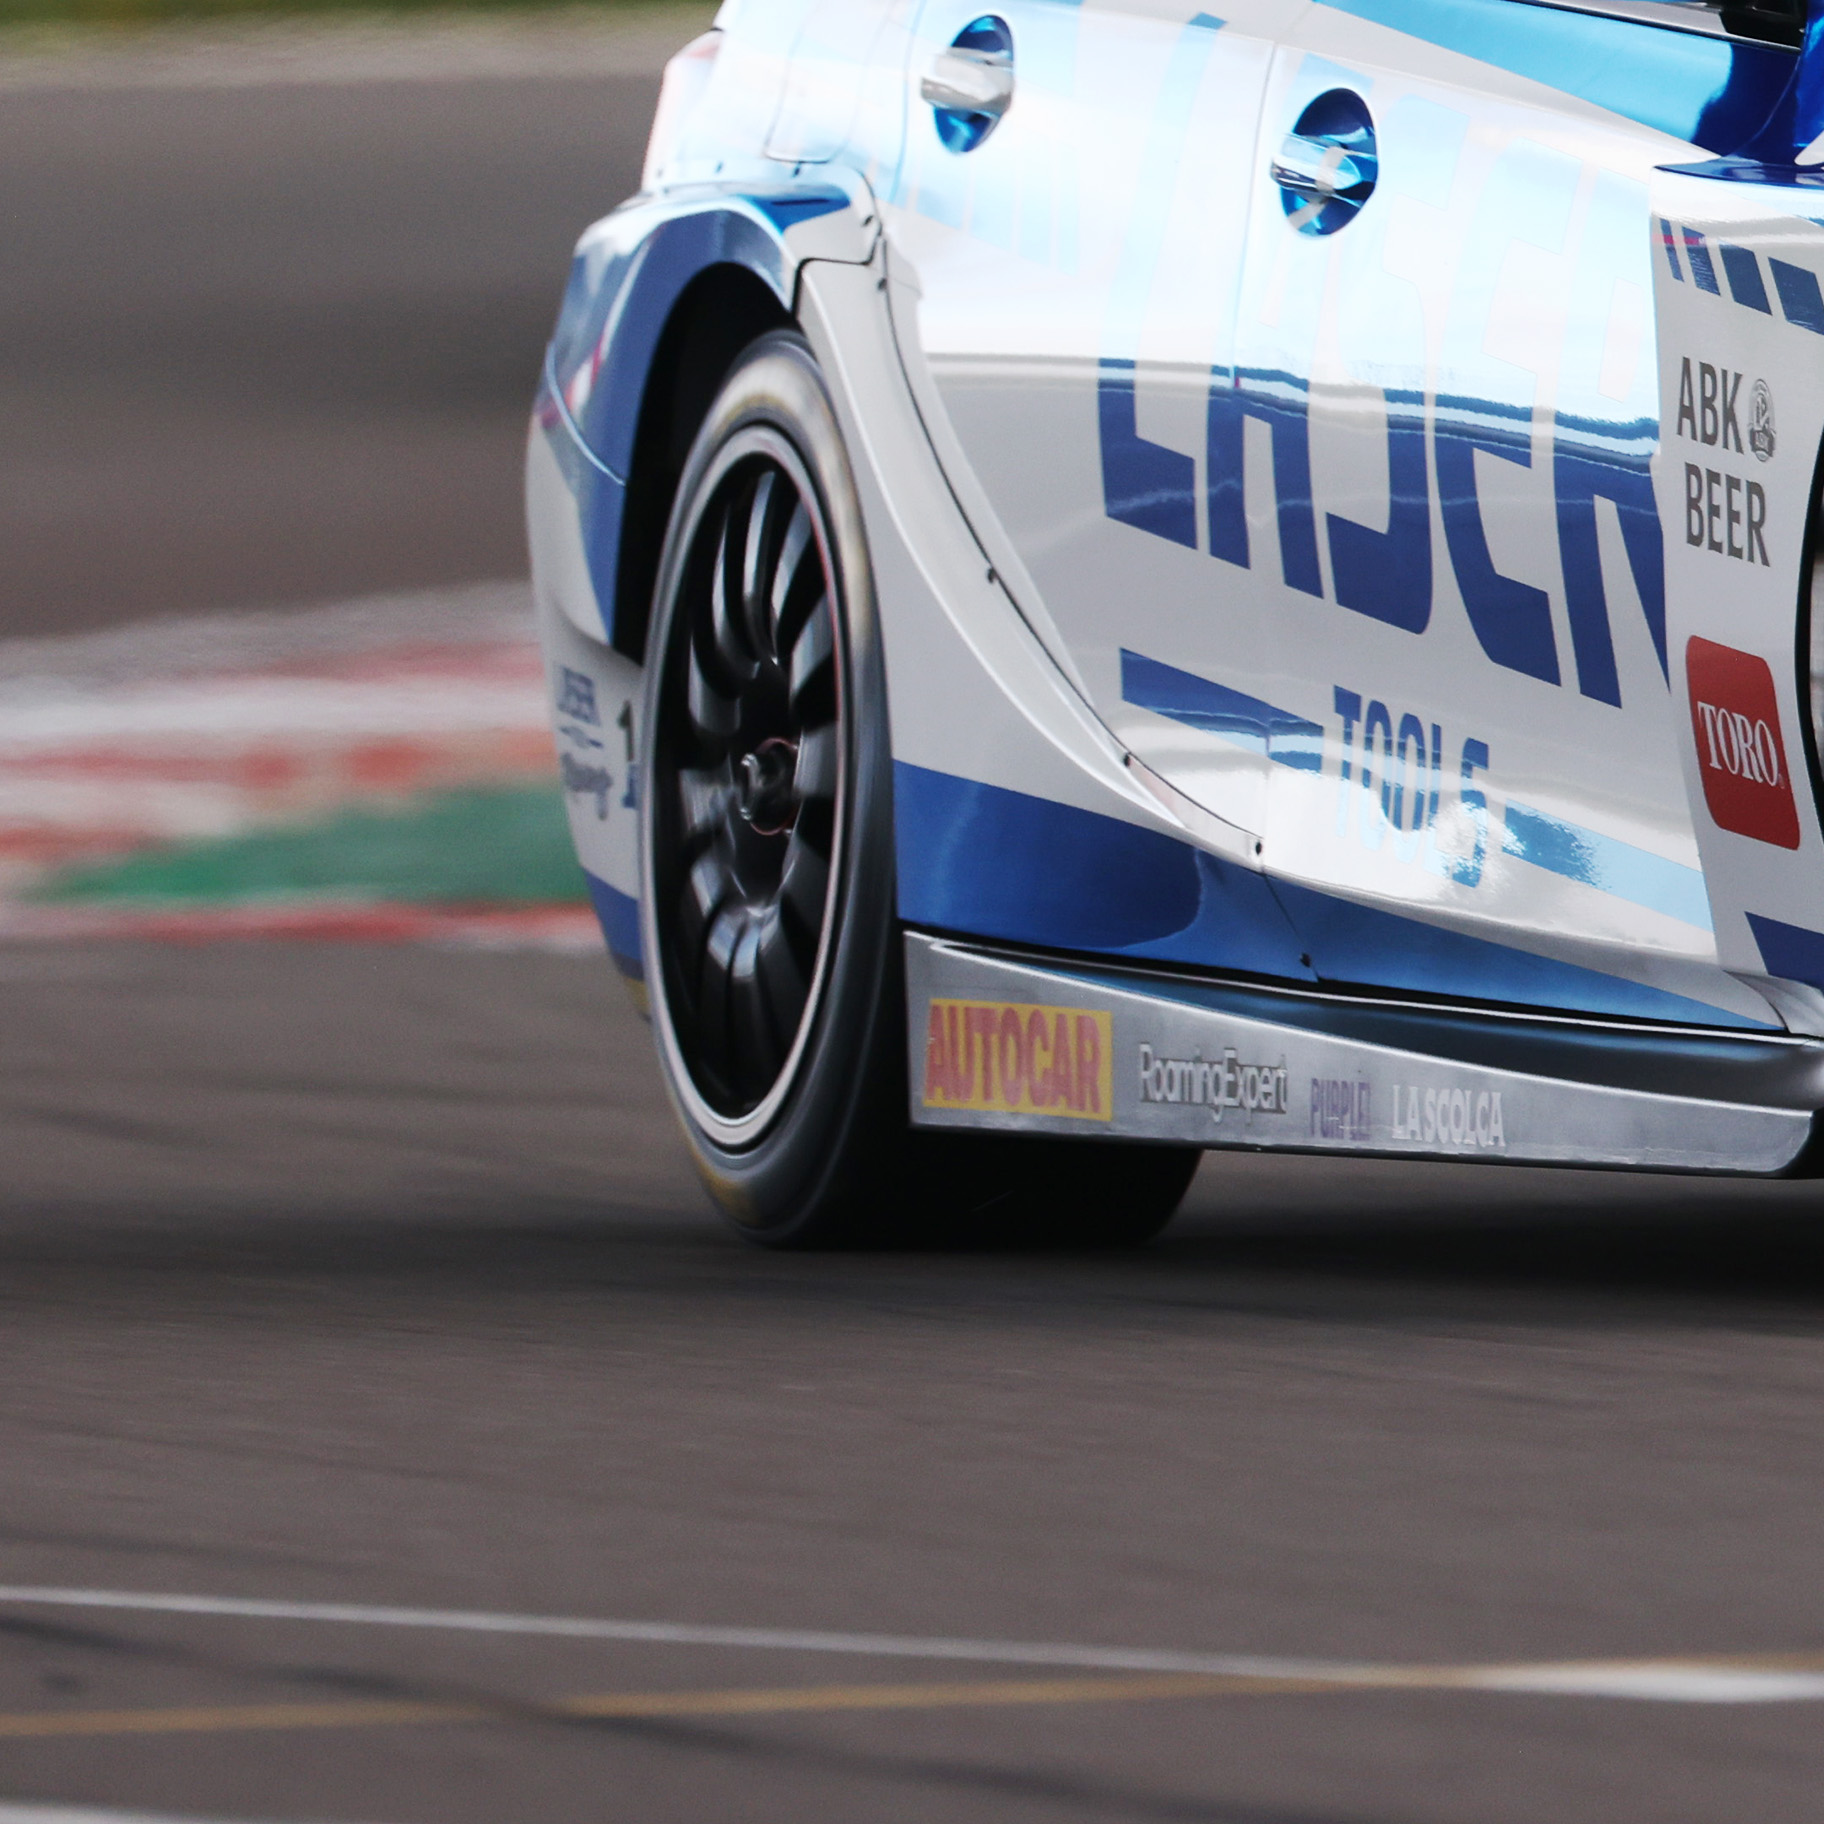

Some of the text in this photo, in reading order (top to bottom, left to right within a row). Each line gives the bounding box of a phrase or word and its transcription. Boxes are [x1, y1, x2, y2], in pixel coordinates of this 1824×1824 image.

[1676, 356, 1745, 456] ABK
[1683, 460, 1771, 567] BEER
[1333, 686, 1490, 889] TOOLS
[1698, 700, 1780, 788] TORO
[926, 1003, 1103, 1114] AUTOCAR
